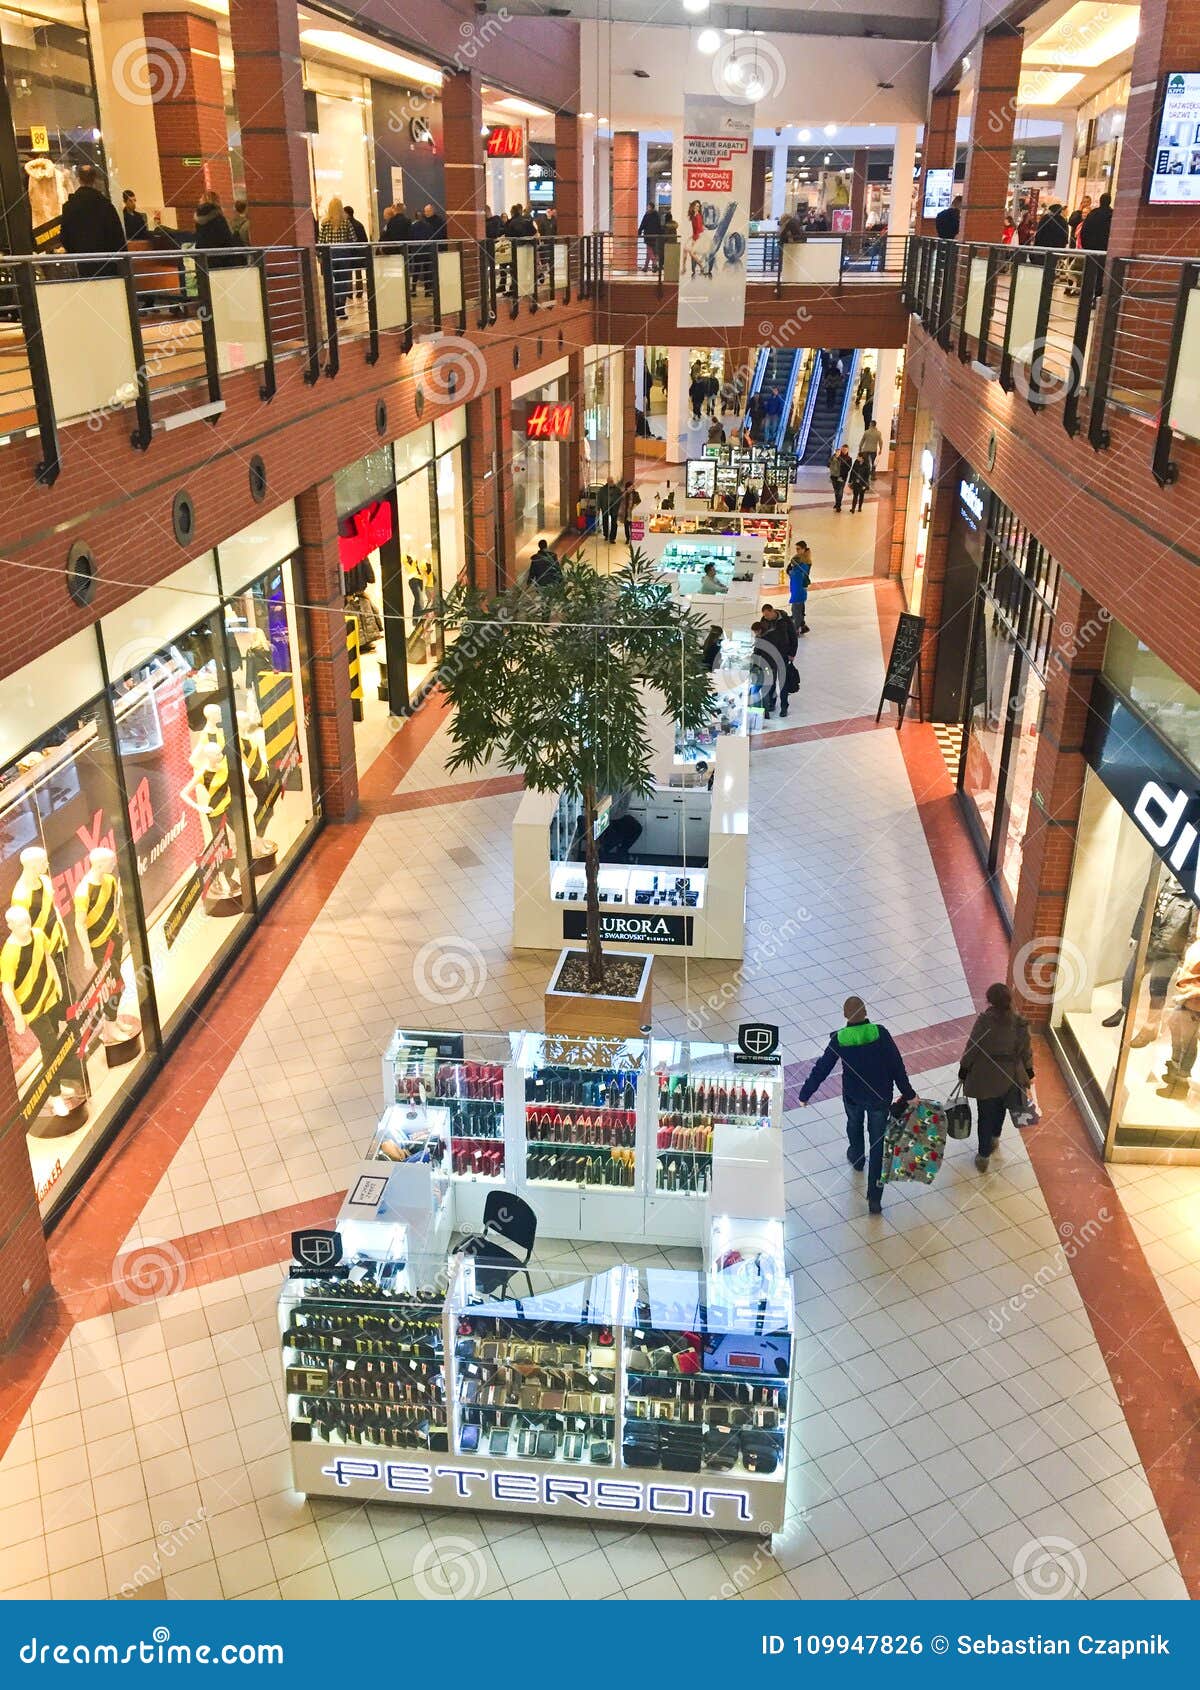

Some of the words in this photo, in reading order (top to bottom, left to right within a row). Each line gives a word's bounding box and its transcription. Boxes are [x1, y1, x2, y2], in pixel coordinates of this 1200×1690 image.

[34, 132, 45, 145] 89
[688, 140, 716, 148] WIELKIE
[690, 179, 705, 189] DO
[707, 180, 730, 190] -70%
[528, 404, 573, 438] H&M
[600, 917, 671, 934] URORA
[321, 1456, 753, 1521] PETERSON
